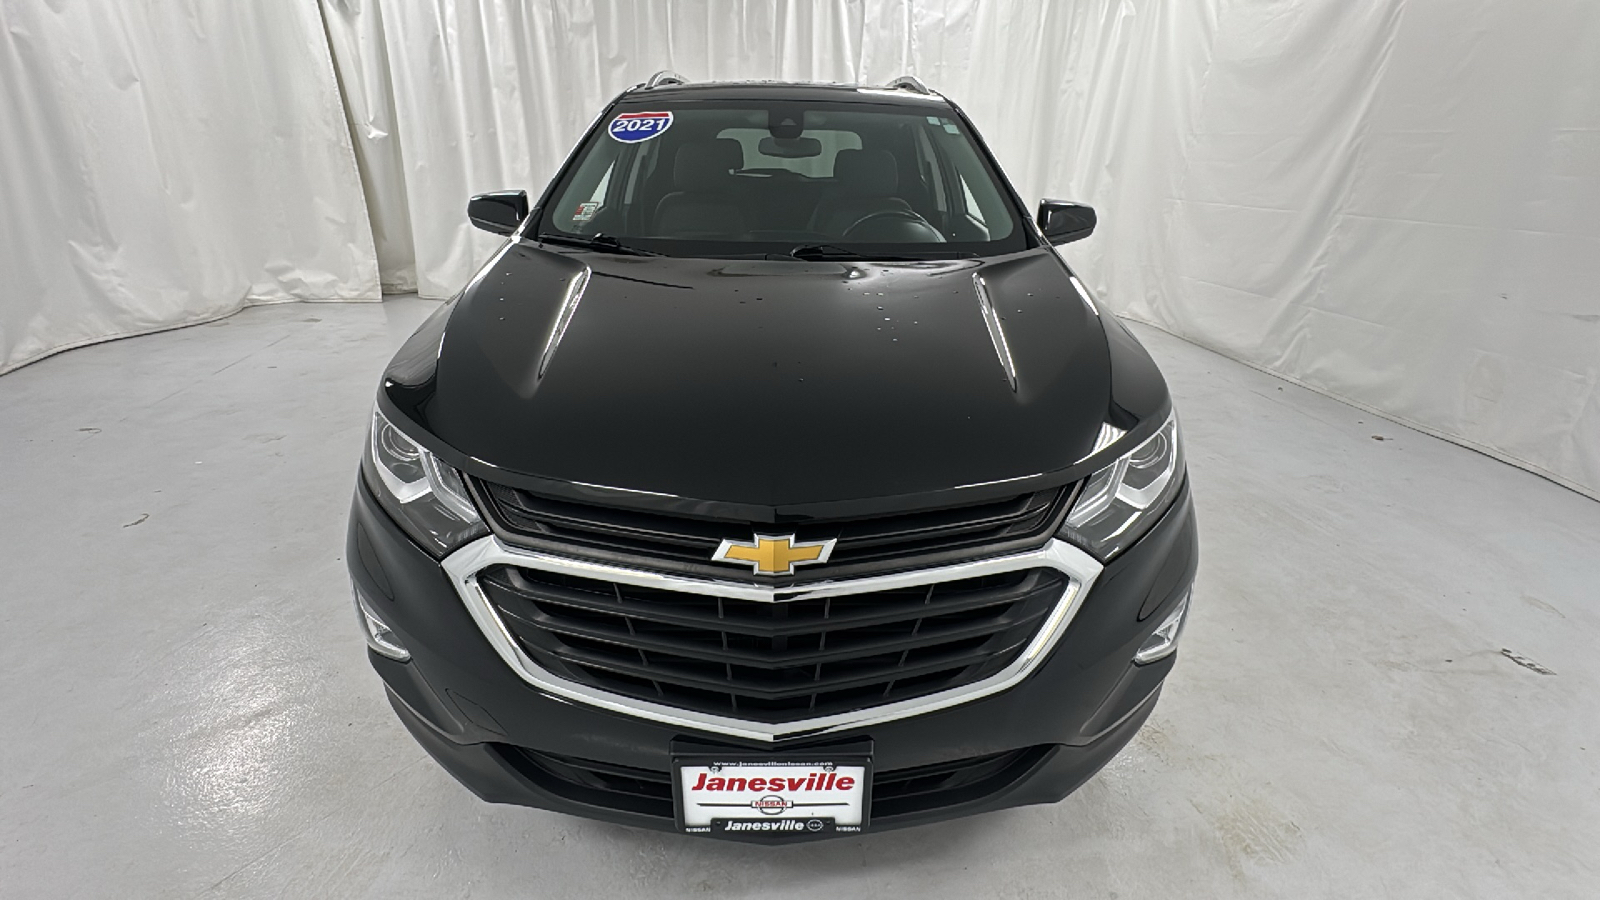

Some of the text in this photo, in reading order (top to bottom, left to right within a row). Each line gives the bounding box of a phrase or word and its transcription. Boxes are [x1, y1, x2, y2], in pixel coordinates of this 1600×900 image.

[613, 119, 665, 132] 2021
[692, 773, 855, 791] Janesville
[724, 820, 805, 831] Janesville
